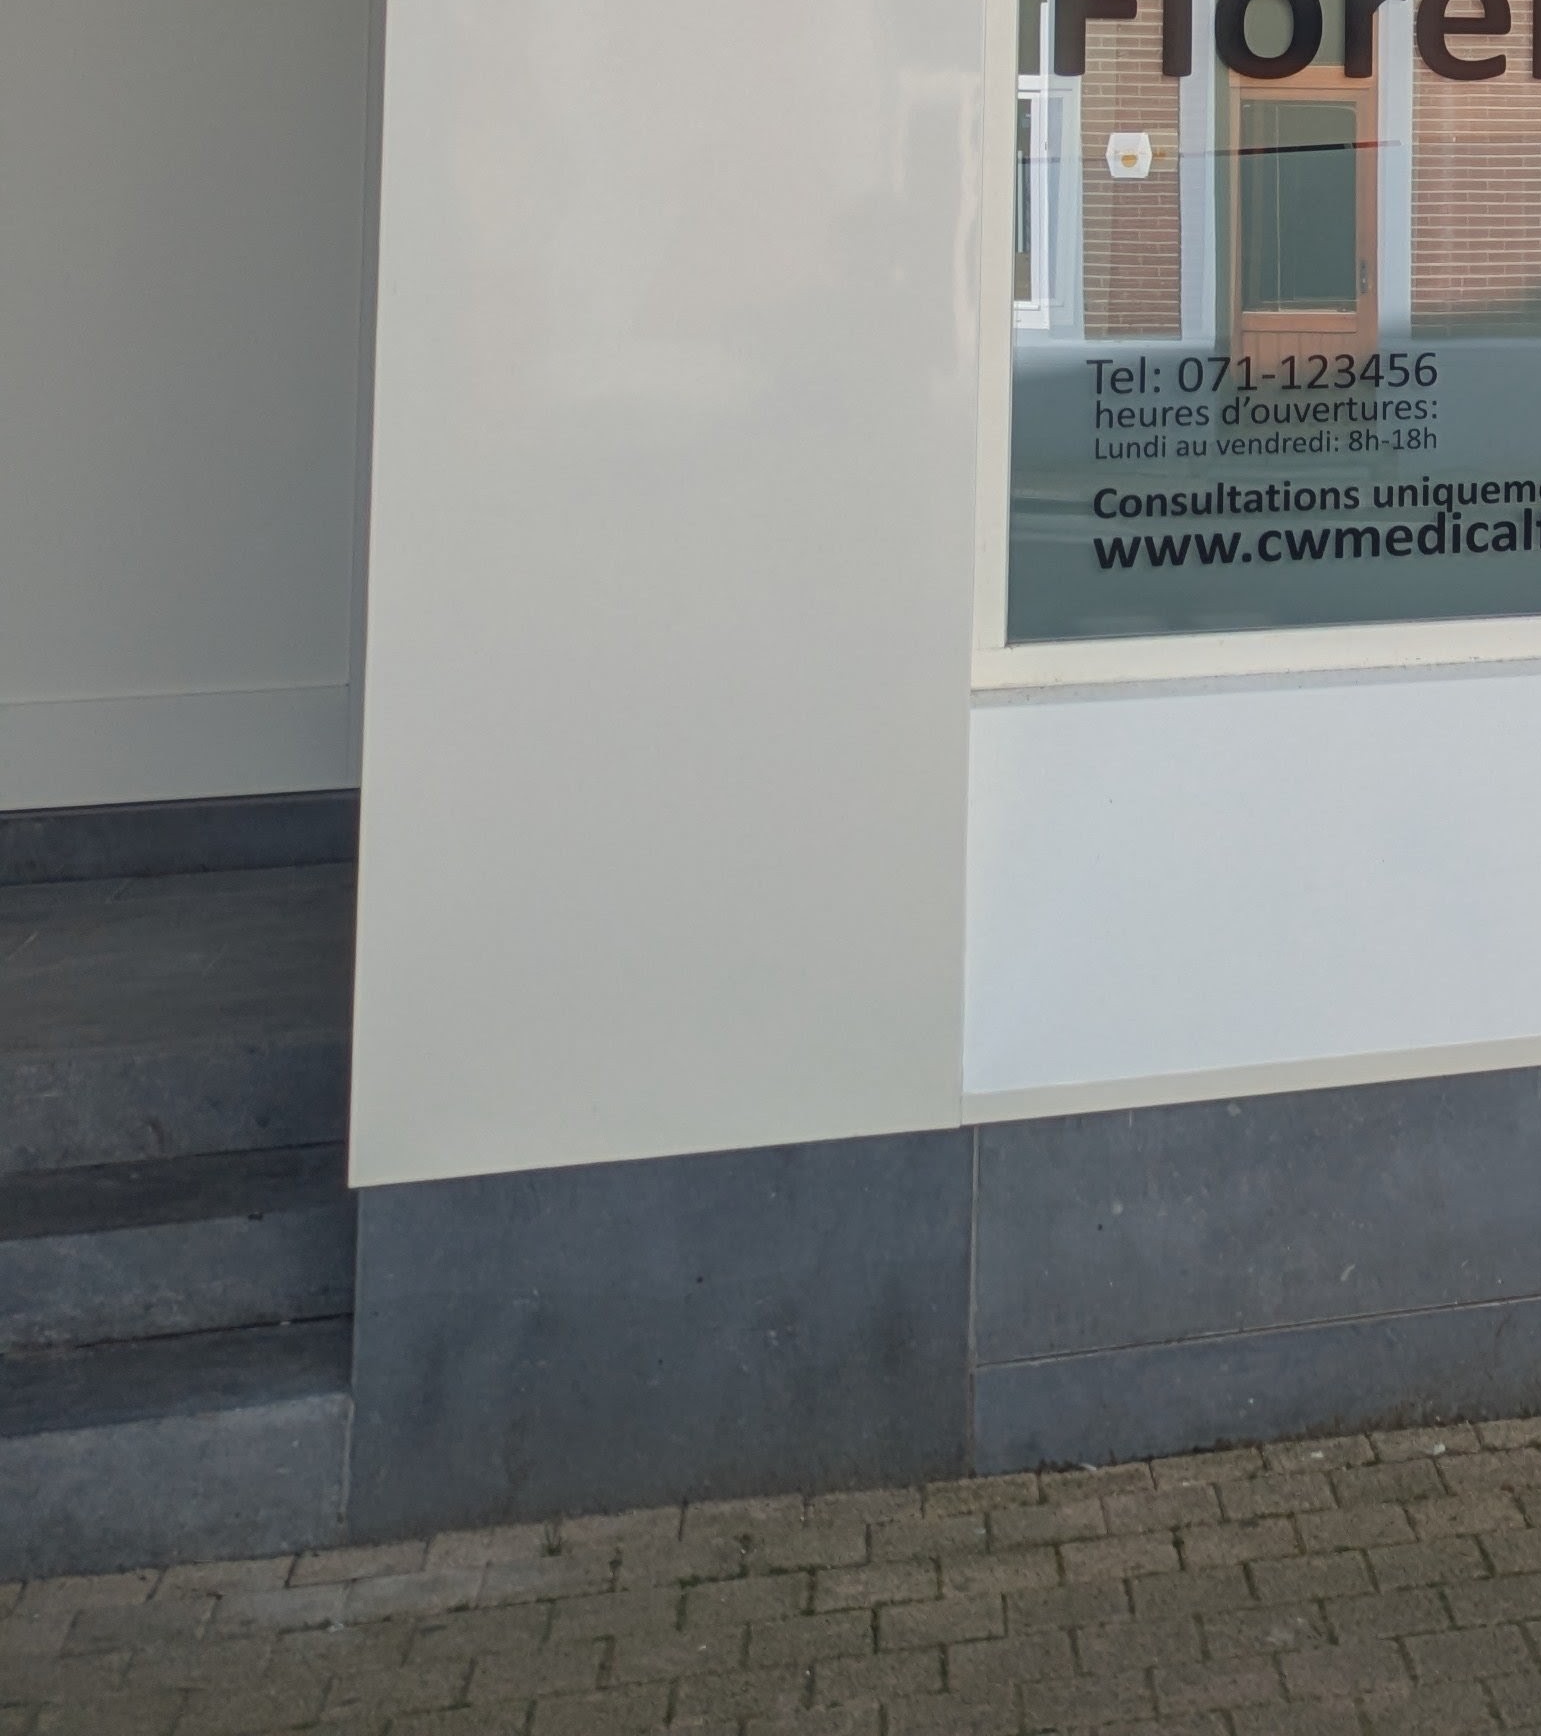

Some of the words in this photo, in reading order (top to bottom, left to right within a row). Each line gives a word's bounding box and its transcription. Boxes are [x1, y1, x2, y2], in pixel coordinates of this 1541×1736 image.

[1086, 357, 1161, 395] Tel:
[1177, 352, 1438, 395] 071-123456
[1095, 399, 1210, 429] heures
[1094, 435, 1167, 460] Lundi
[1176, 439, 1208, 457] au
[1216, 431, 1340, 456] vendredi:
[1348, 428, 1437, 452] 8h-18h
[1093, 481, 1361, 519] Consultations
